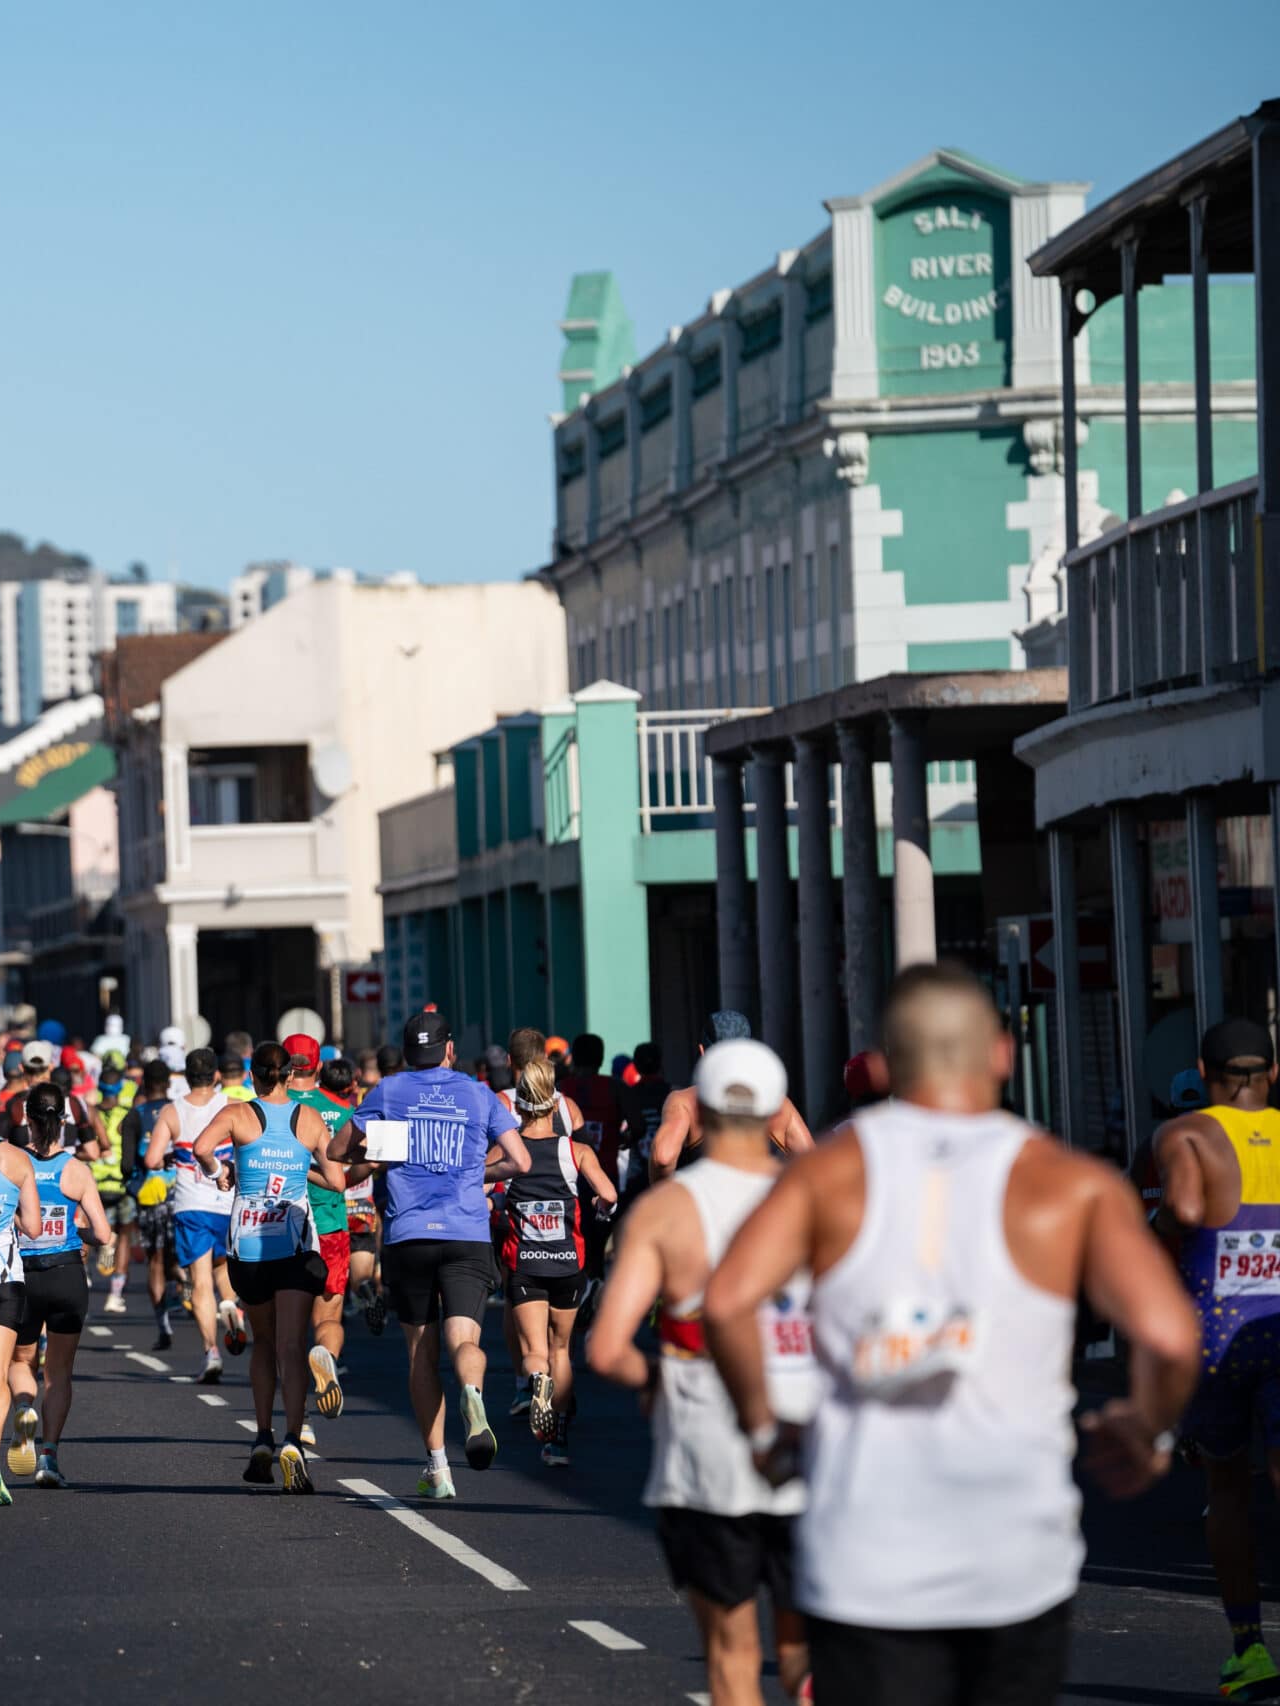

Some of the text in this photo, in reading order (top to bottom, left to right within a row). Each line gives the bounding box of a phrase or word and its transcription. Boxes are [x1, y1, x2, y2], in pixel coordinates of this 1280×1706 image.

[911, 253, 992, 279] RIVER
[408, 1119, 465, 1167] FINISHER
[261, 1147, 294, 1159] Maluti
[248, 1159, 304, 1173] MultiSport
[271, 1177, 283, 1195] 5
[520, 1250, 577, 1260] GOODWOOD
